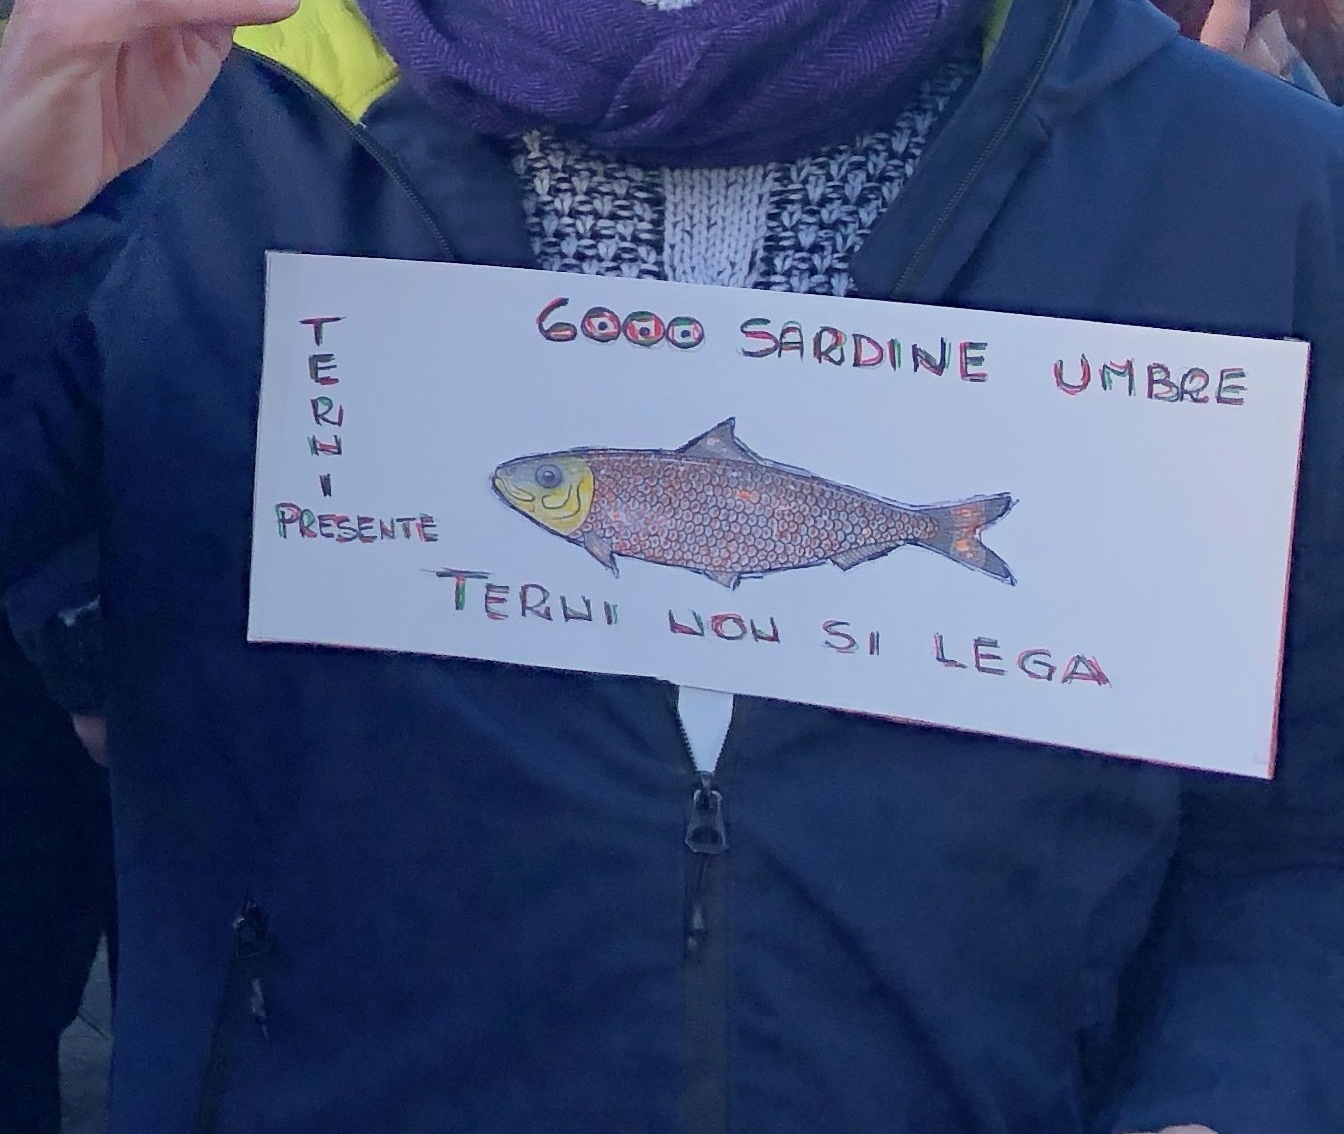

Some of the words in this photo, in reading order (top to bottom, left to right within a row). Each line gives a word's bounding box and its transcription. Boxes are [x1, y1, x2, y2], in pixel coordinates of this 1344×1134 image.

[535, 296, 705, 351] 6000
[739, 317, 989, 383] SARDINE
[1053, 352, 1249, 407] UMBRE
[273, 502, 440, 544] PRESENTE
[428, 567, 619, 626] TERNI
[668, 609, 781, 644] NON
[821, 619, 882, 656] SI
[932, 631, 1113, 689] LEGA
